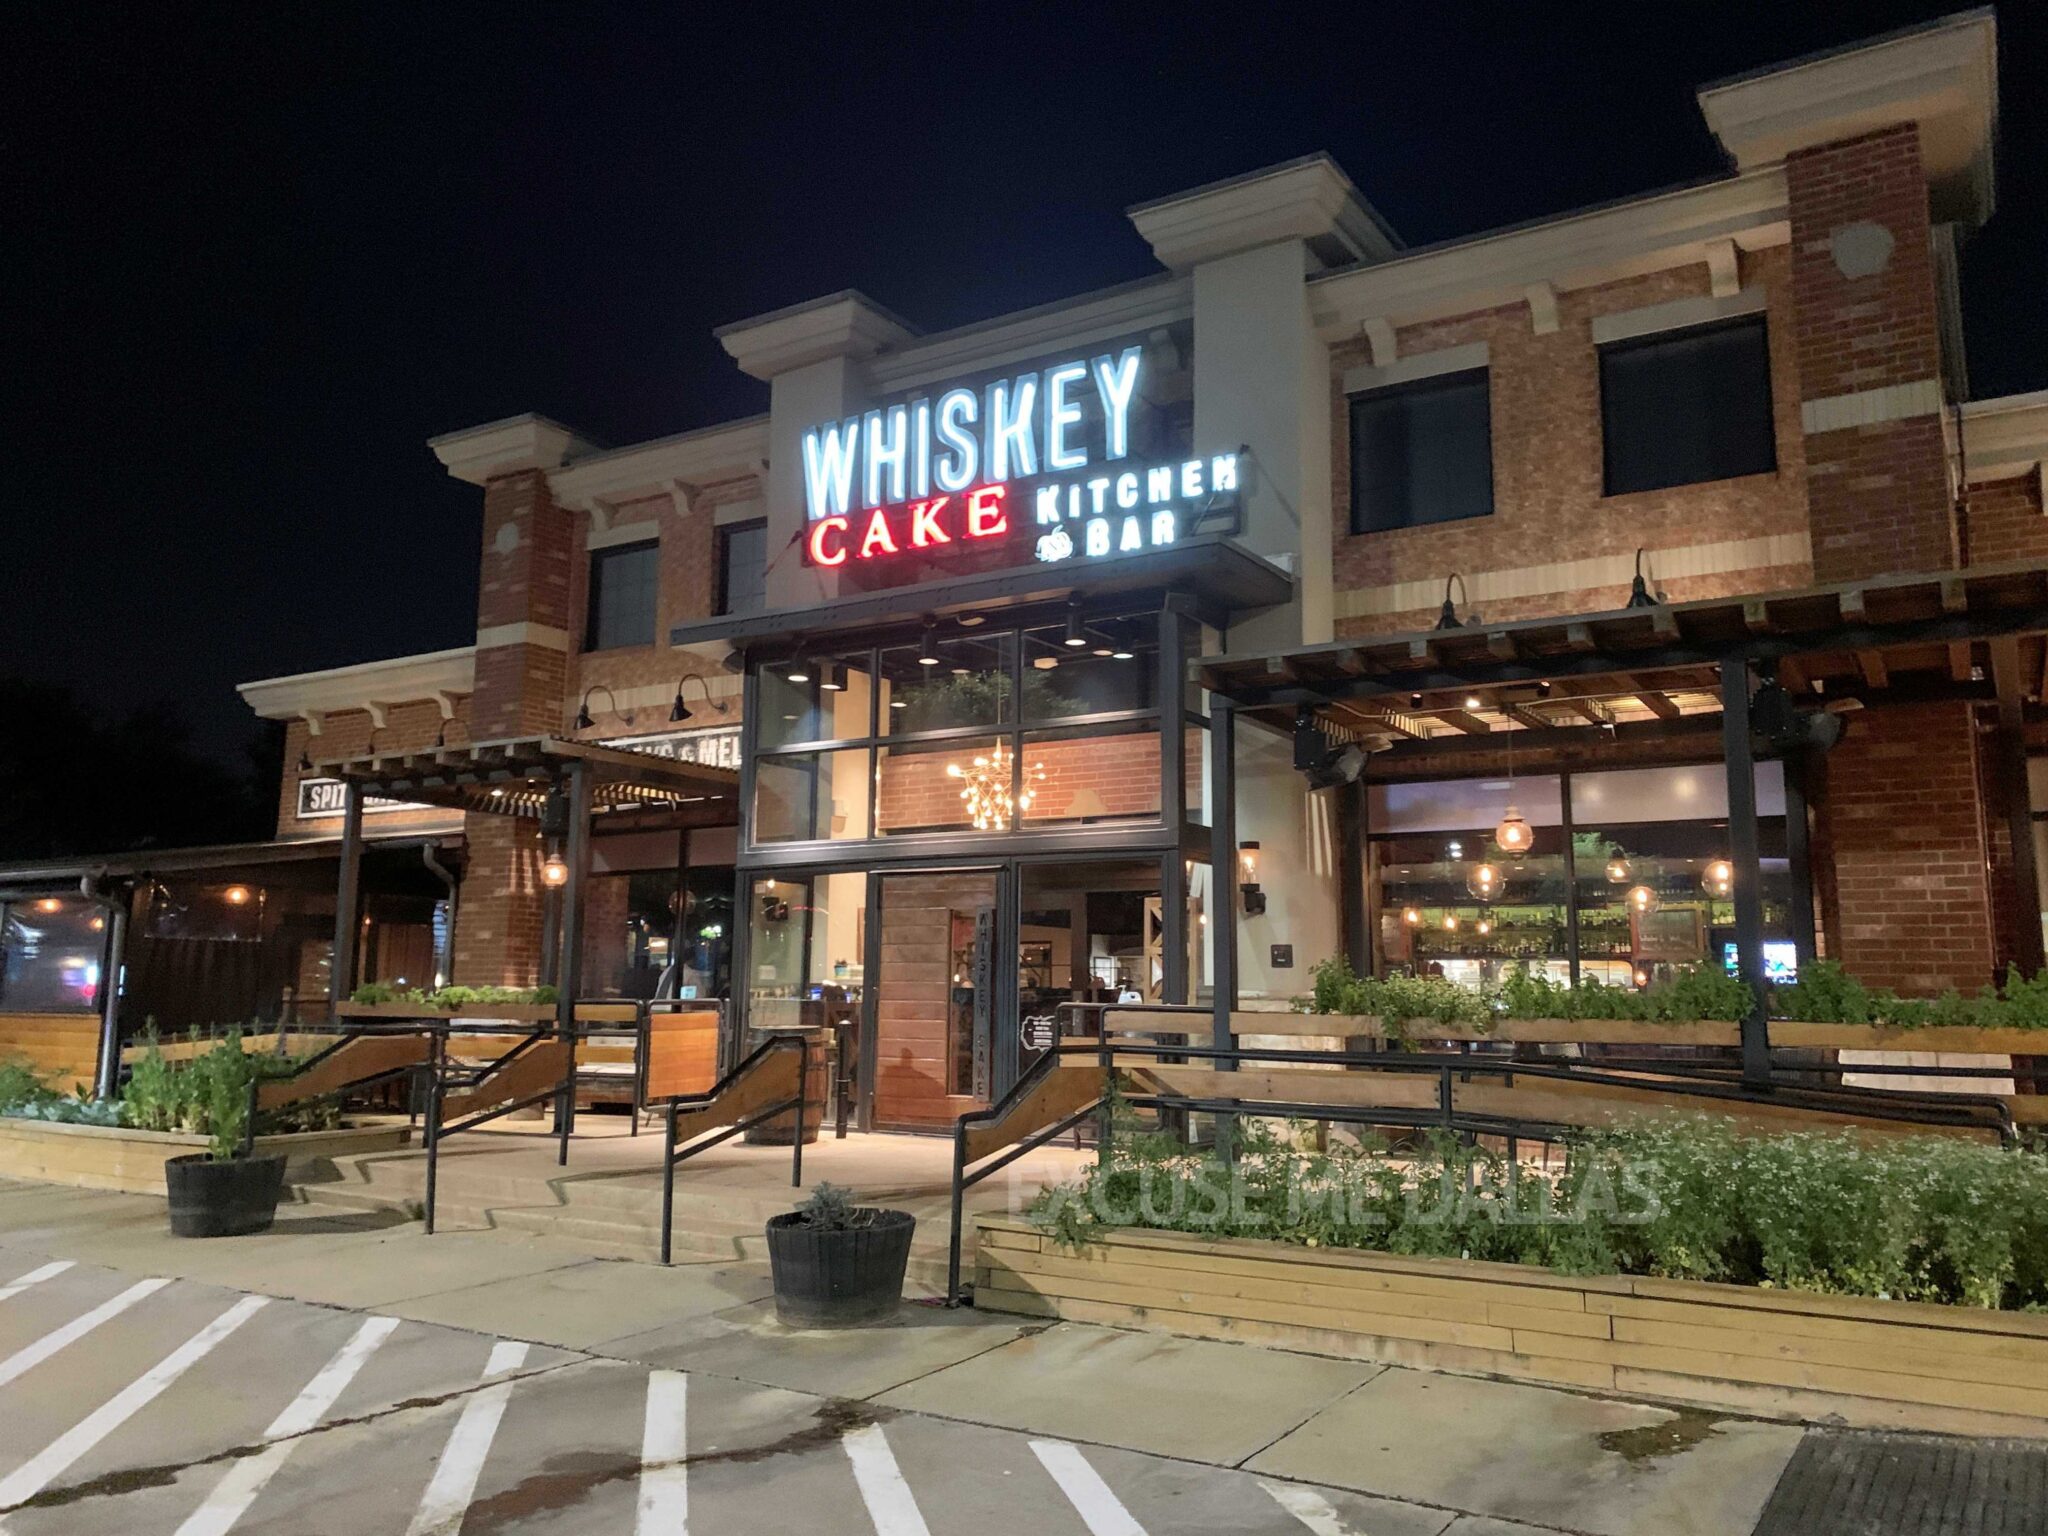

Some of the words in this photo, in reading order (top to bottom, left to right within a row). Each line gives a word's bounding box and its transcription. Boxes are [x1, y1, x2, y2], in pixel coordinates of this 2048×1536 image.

[803, 345, 1142, 519] WHISKEY
[810, 486, 1008, 566] CAKE
[1037, 454, 1237, 524] KITCHEN
[1086, 512, 1174, 557] BAR
